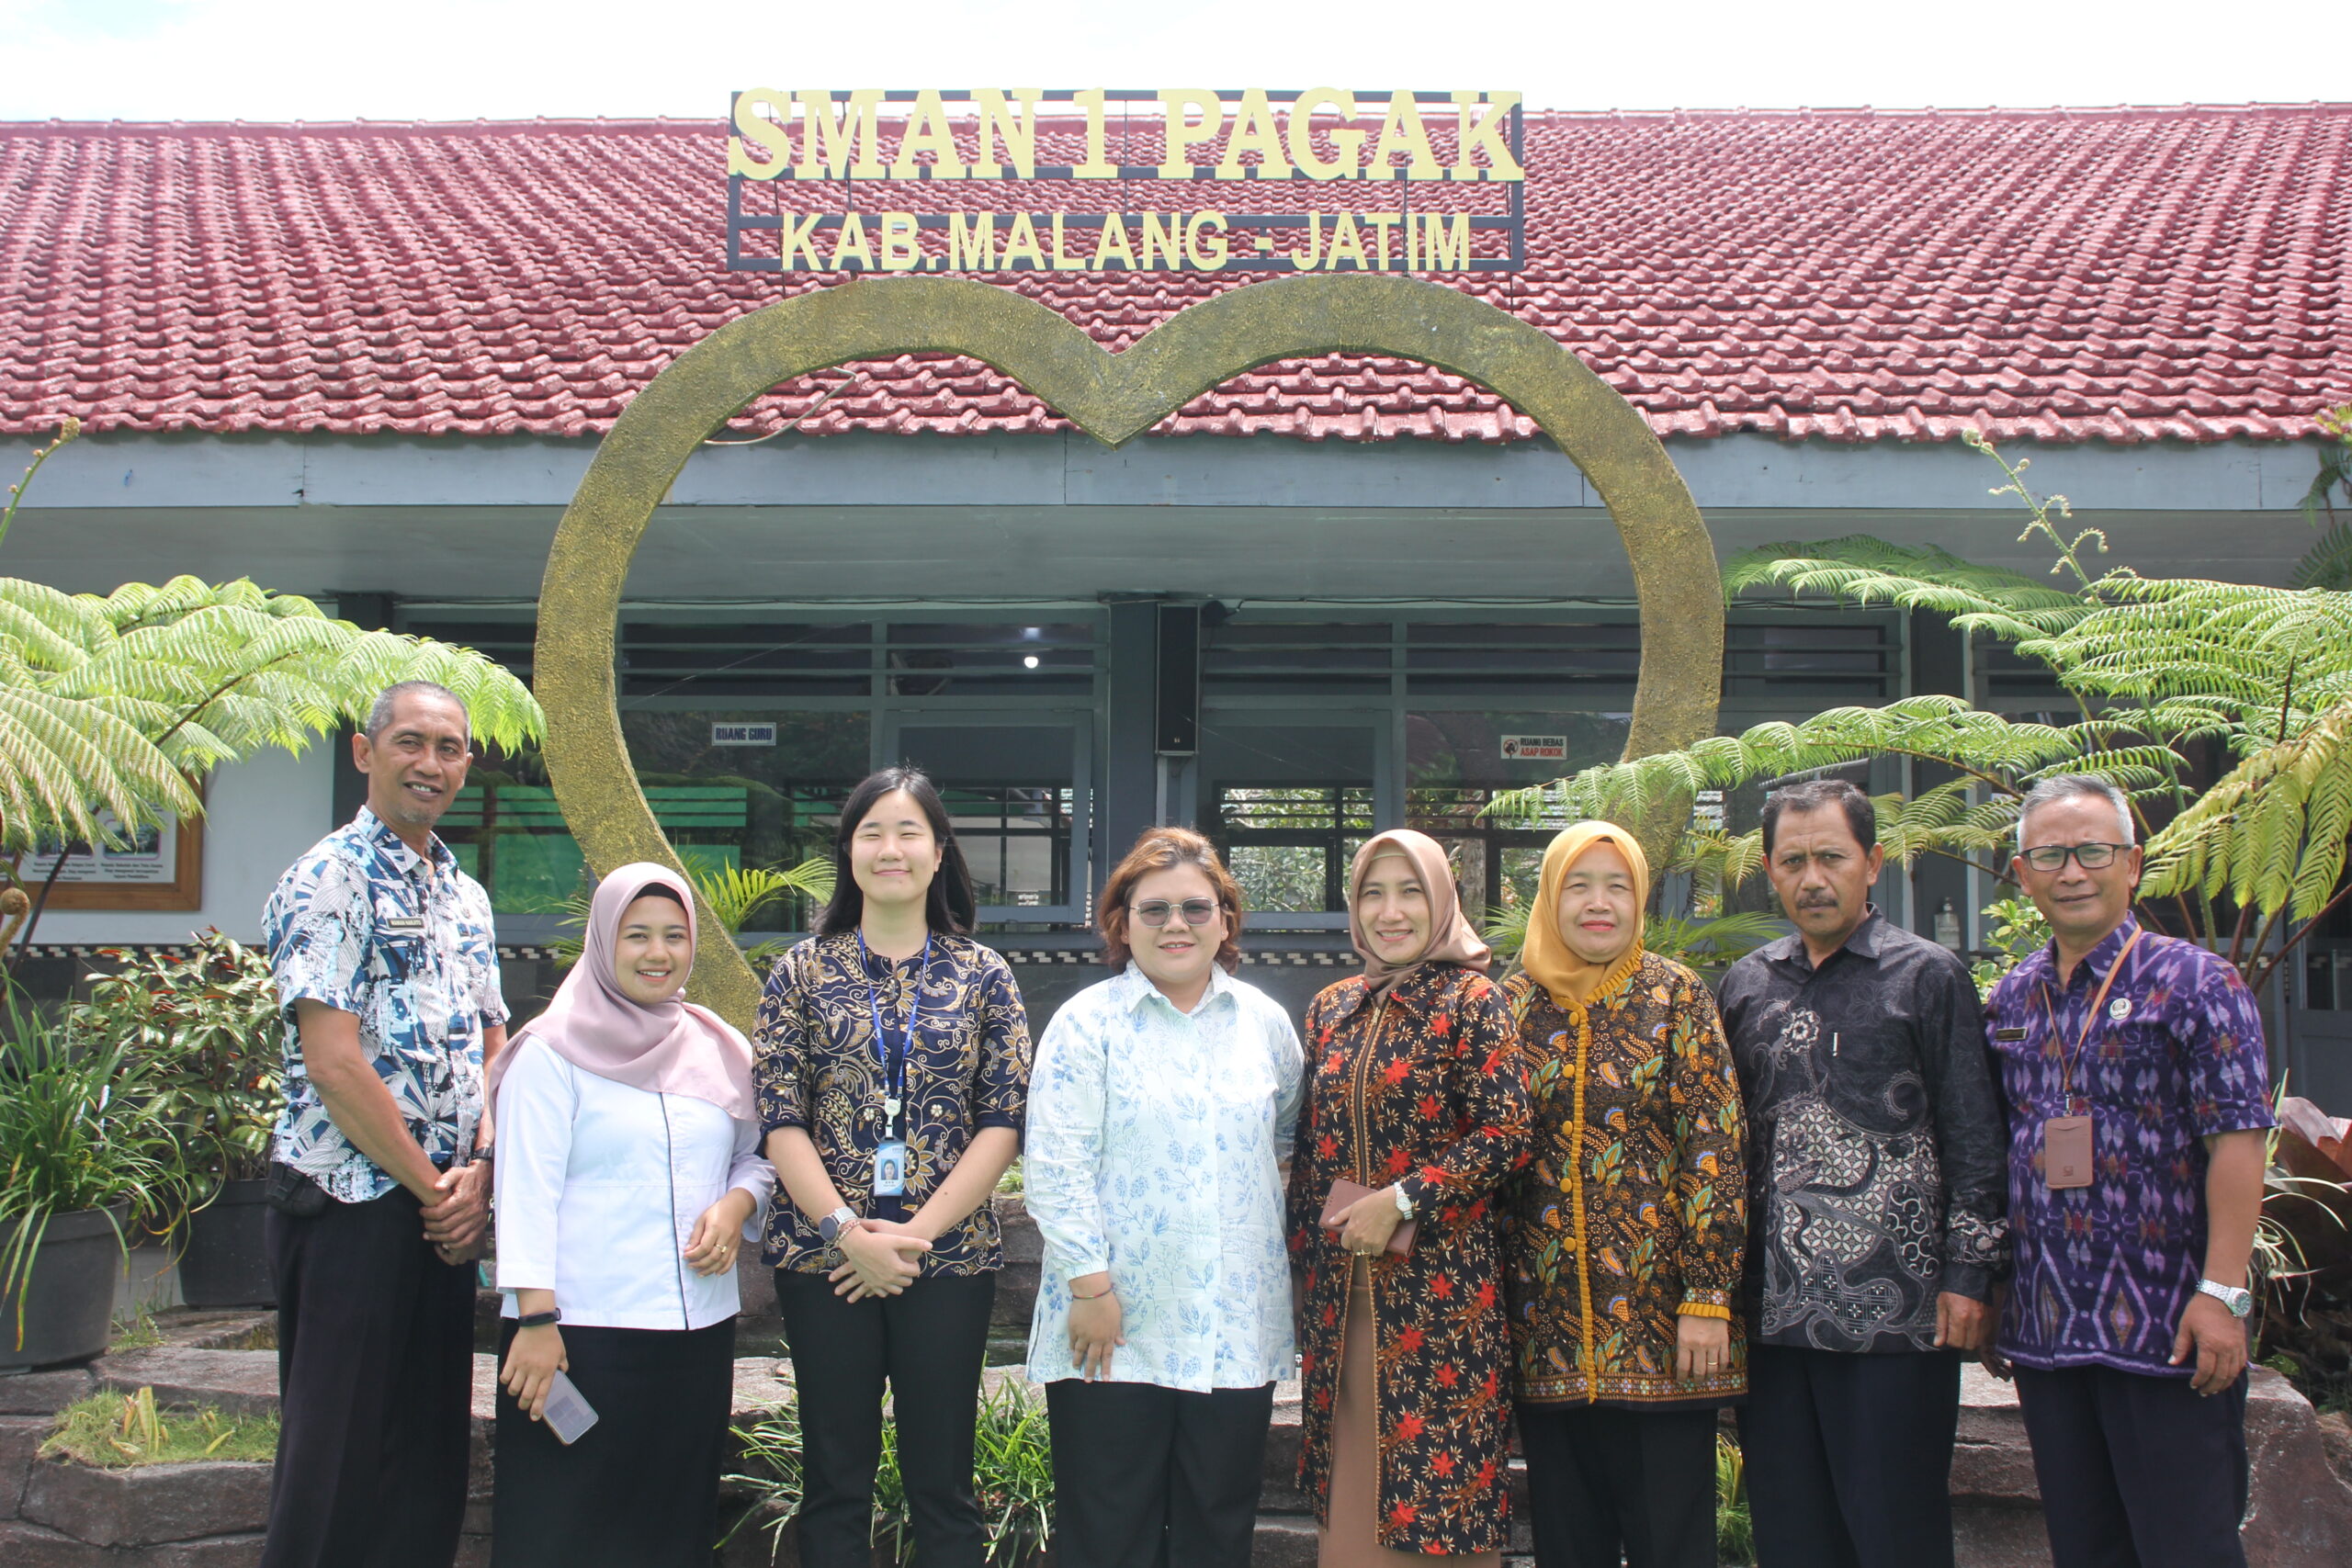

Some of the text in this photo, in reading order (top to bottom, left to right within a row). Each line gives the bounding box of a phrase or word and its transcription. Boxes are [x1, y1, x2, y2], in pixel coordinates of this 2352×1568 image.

[729, 86, 1525, 182] SMAN 1 PAGAK
[1290, 210, 1470, 272] JATIM
[715, 727, 773, 741] RUANG GURU
[1520, 738, 1564, 747] RUANG BEBAS
[1520, 747, 1564, 757] ASAP ROKOK
